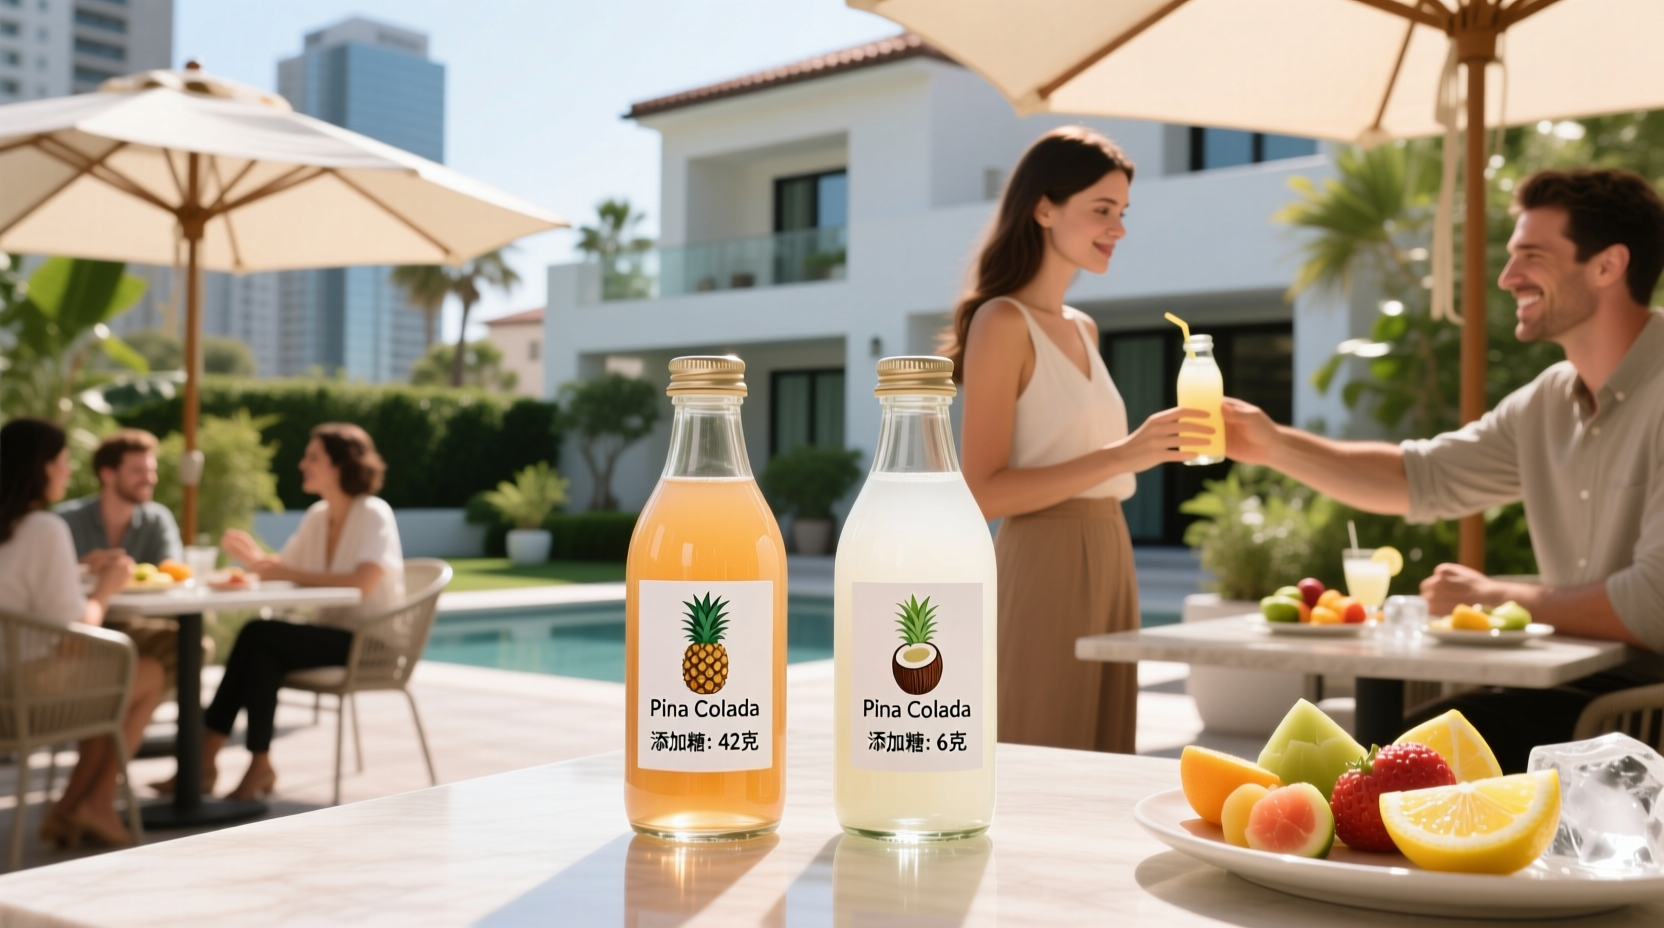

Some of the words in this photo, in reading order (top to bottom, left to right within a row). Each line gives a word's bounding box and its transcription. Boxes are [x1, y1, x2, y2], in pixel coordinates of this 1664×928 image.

[650, 698, 689, 718] Pina
[694, 698, 760, 718] Colada
[863, 699, 902, 718] Pina
[907, 698, 971, 719] Colada
